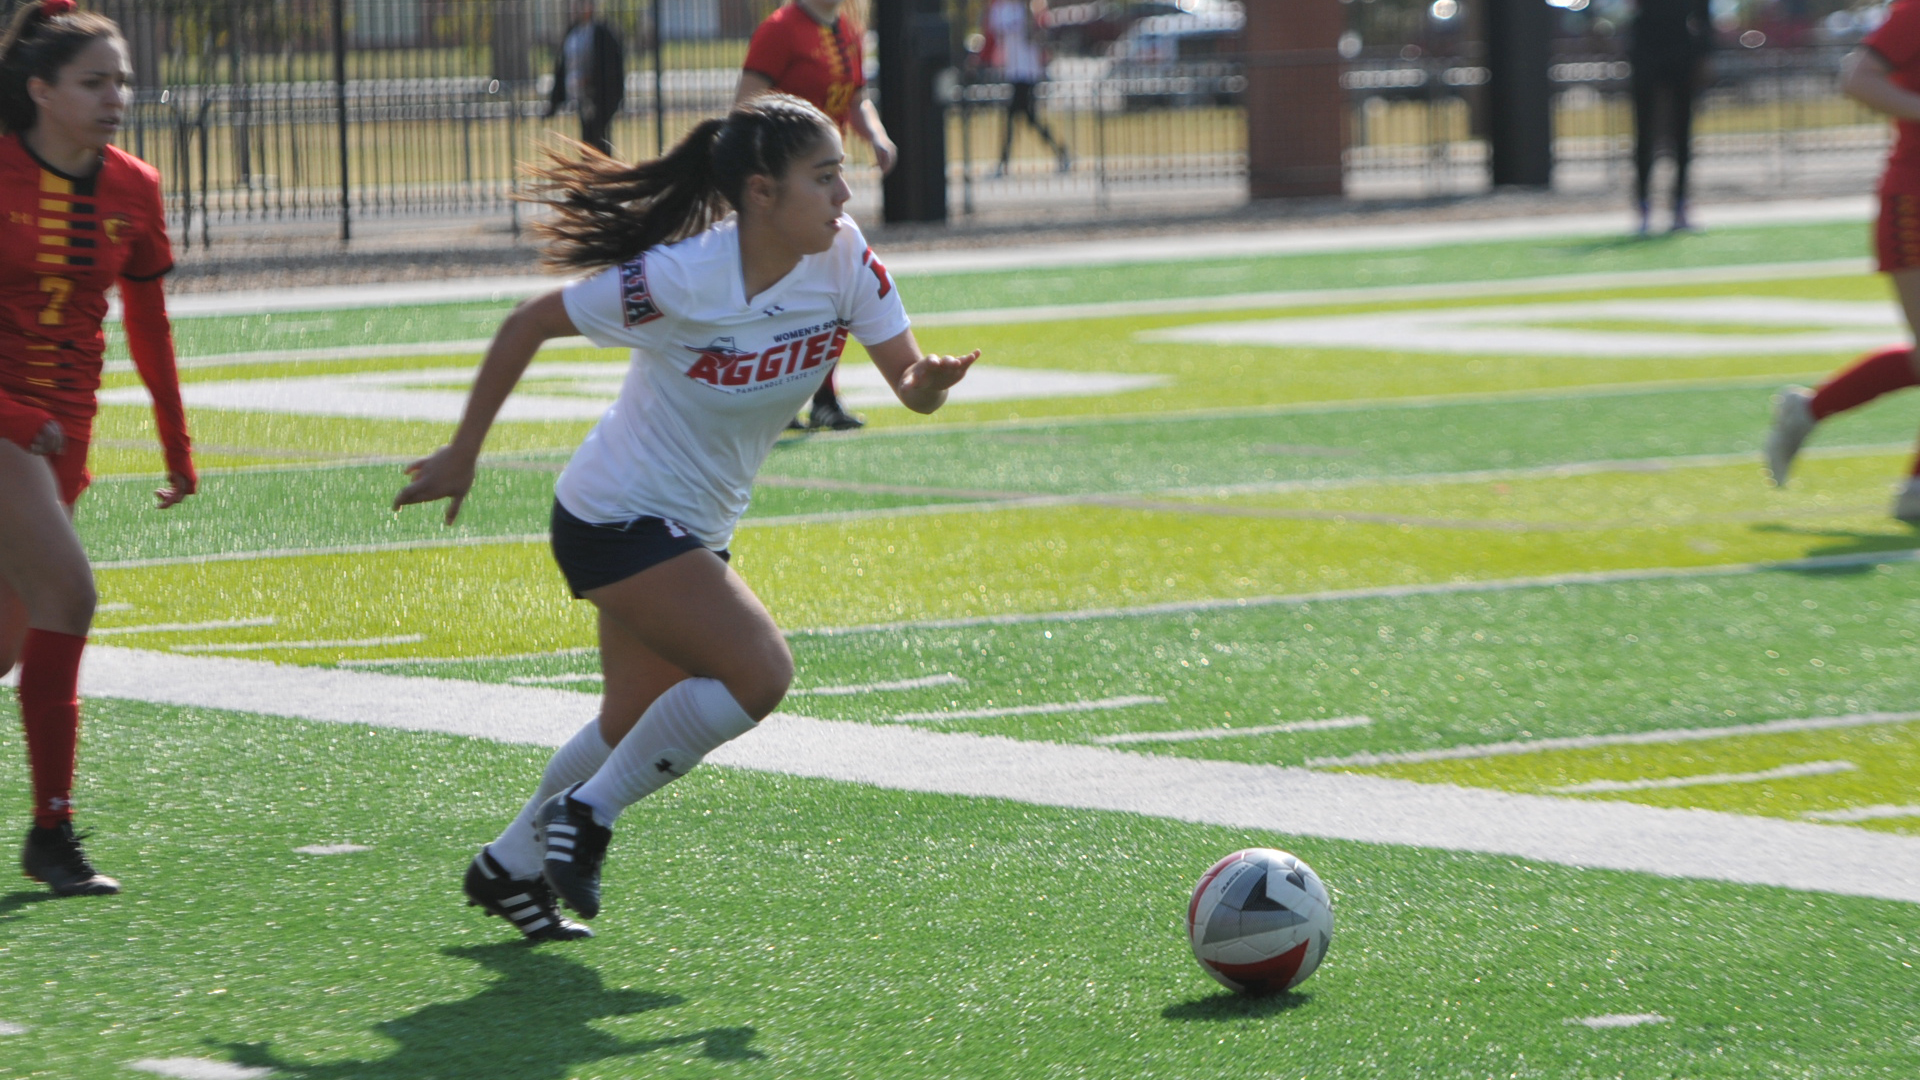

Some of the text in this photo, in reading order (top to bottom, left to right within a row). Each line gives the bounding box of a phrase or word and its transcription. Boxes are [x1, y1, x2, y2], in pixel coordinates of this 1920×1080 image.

[38, 276, 73, 325] 7
[773, 324, 820, 343] WOMEN'S
[685, 325, 849, 386] AGGIES
[736, 371, 808, 395] PANHANDLE STATE
